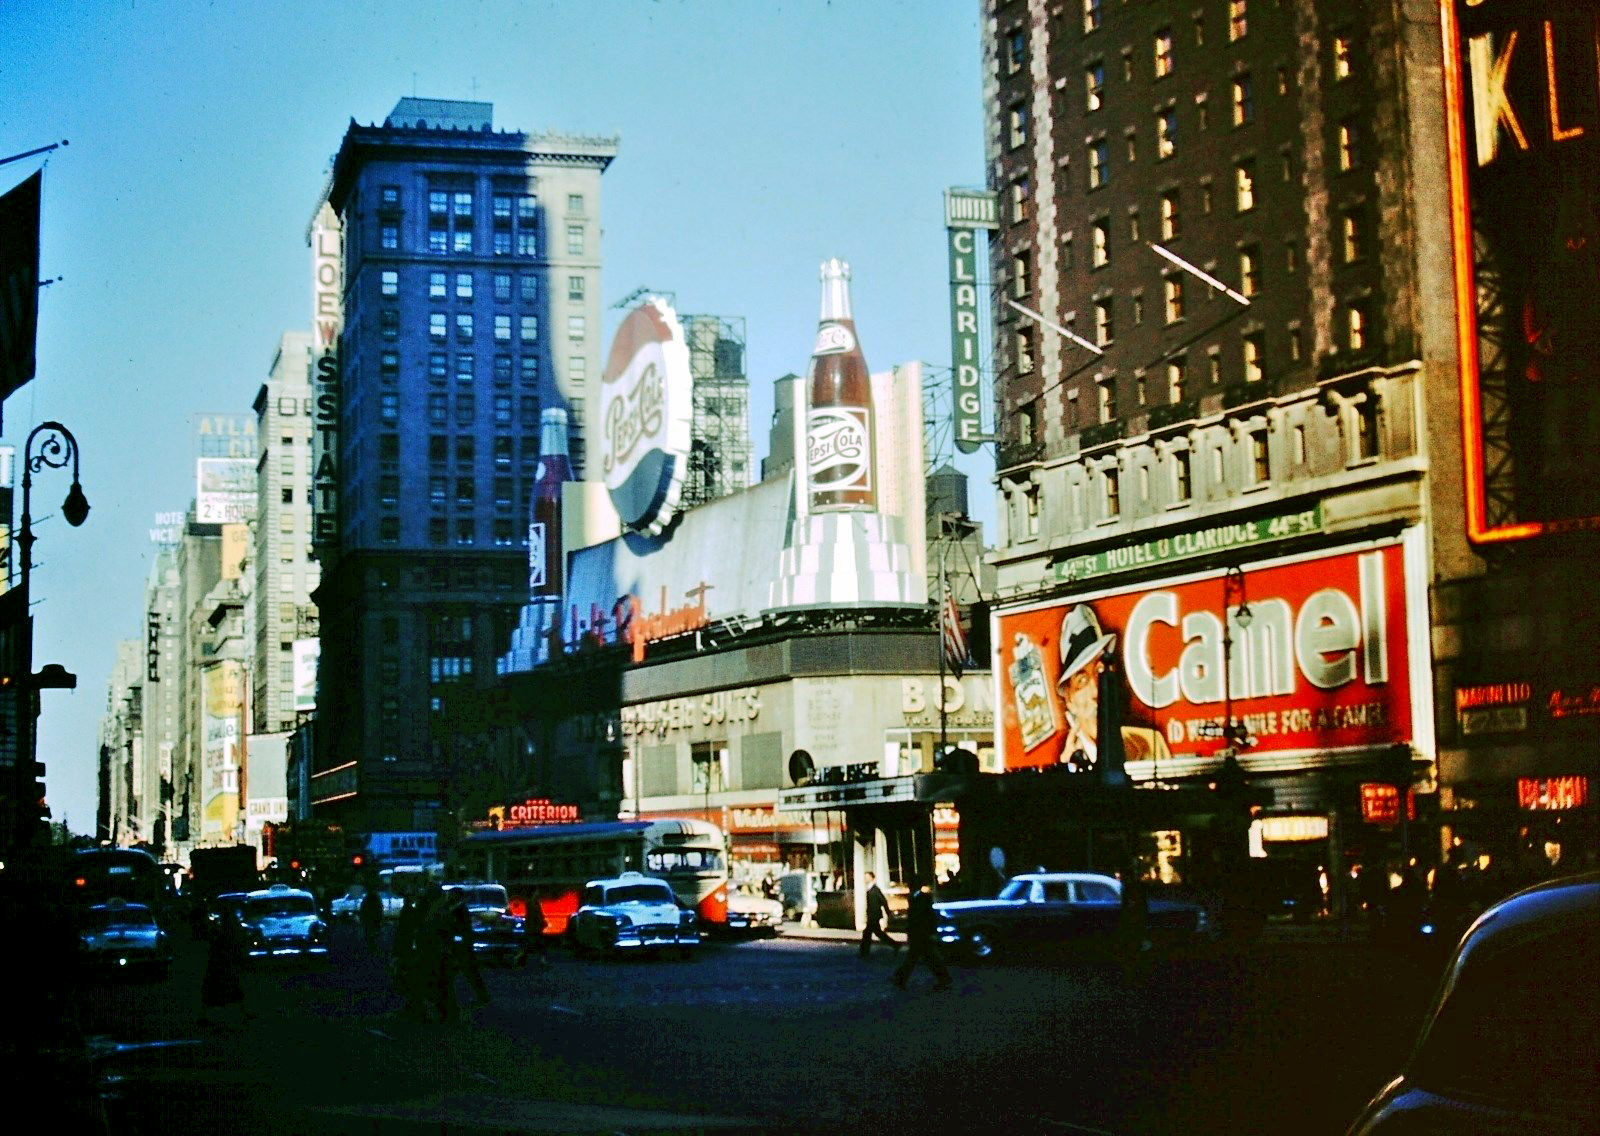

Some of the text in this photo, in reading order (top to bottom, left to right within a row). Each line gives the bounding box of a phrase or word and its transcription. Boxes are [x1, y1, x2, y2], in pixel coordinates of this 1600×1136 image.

[953, 231, 980, 441] CLARIDGE
[316, 394, 338, 541] STATE
[1106, 542, 1155, 569] HOTEL
[1174, 521, 1260, 553] CLARIDGE
[1123, 550, 1390, 710] Camel
[702, 685, 762, 728] SUITS
[1281, 708, 1313, 735] FOR
[510, 805, 578, 821] CRITERION
